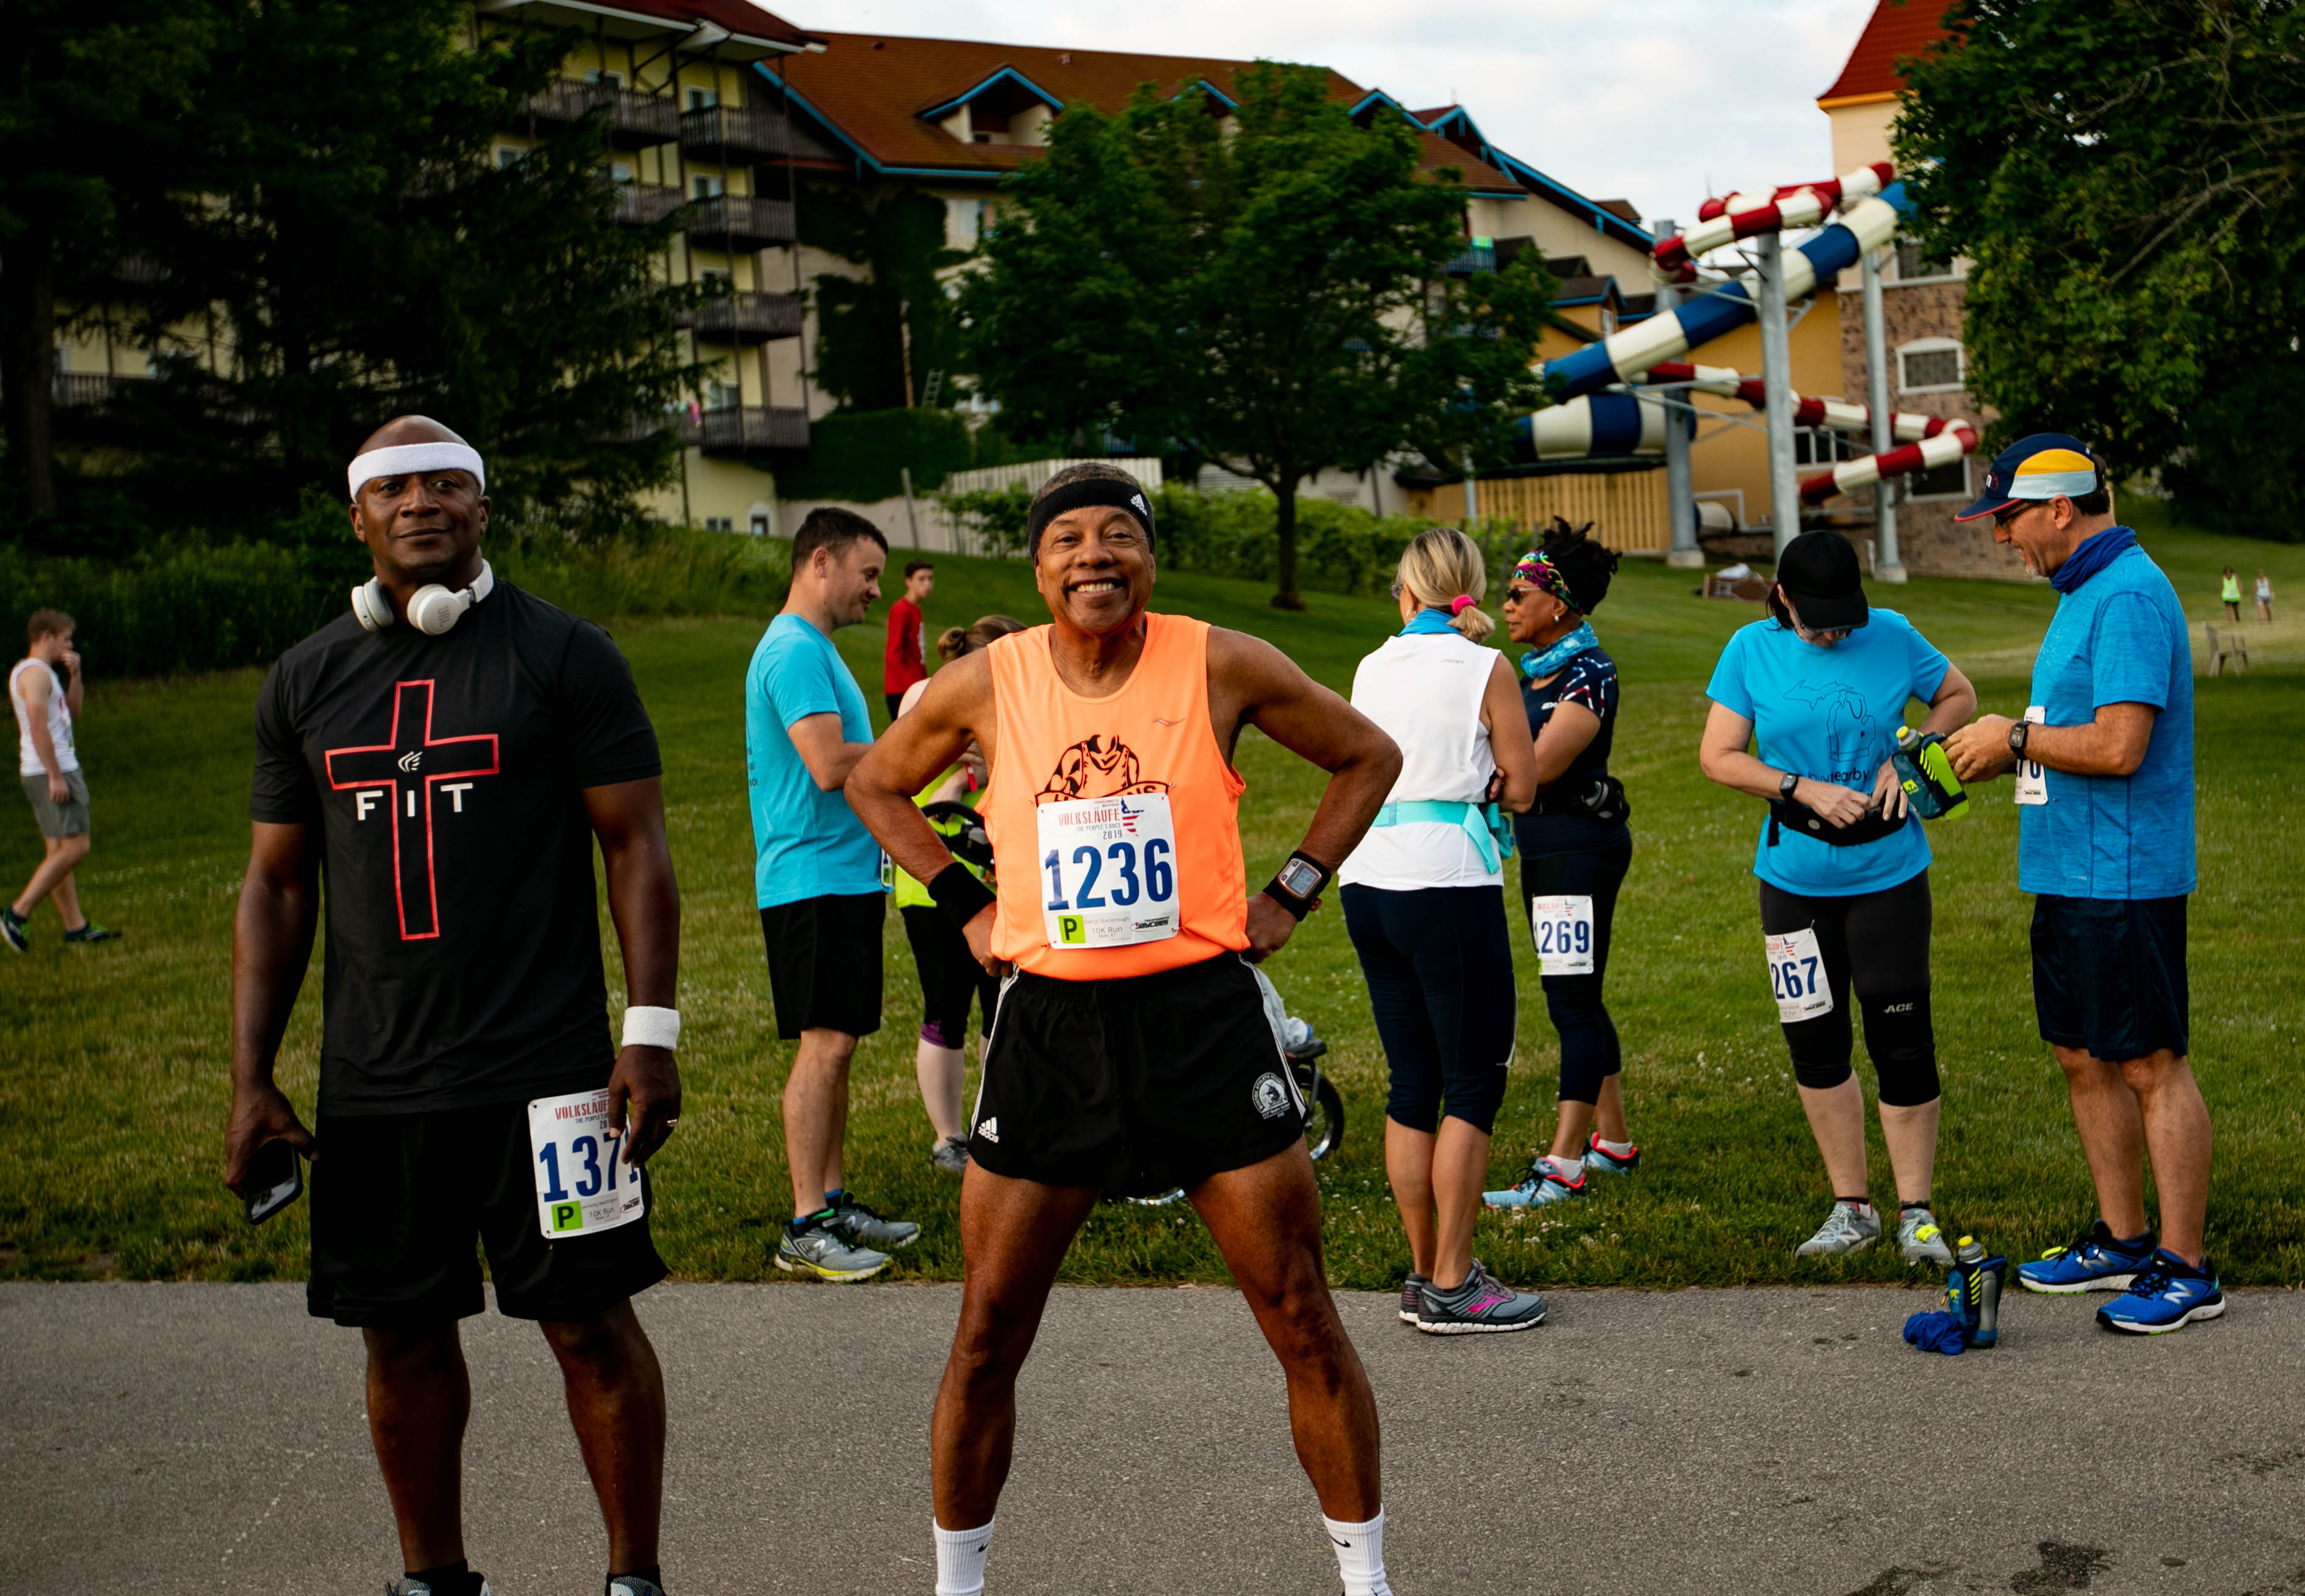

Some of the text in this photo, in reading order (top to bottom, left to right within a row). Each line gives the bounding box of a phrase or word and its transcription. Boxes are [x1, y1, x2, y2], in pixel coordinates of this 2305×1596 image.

[355, 782, 474, 821] FIT
[1103, 830, 1123, 840] 2019
[1045, 838, 1172, 911] 1236
[1063, 917, 1077, 940] P
[1771, 955, 1818, 999] 267
[557, 1206, 574, 1228] P
